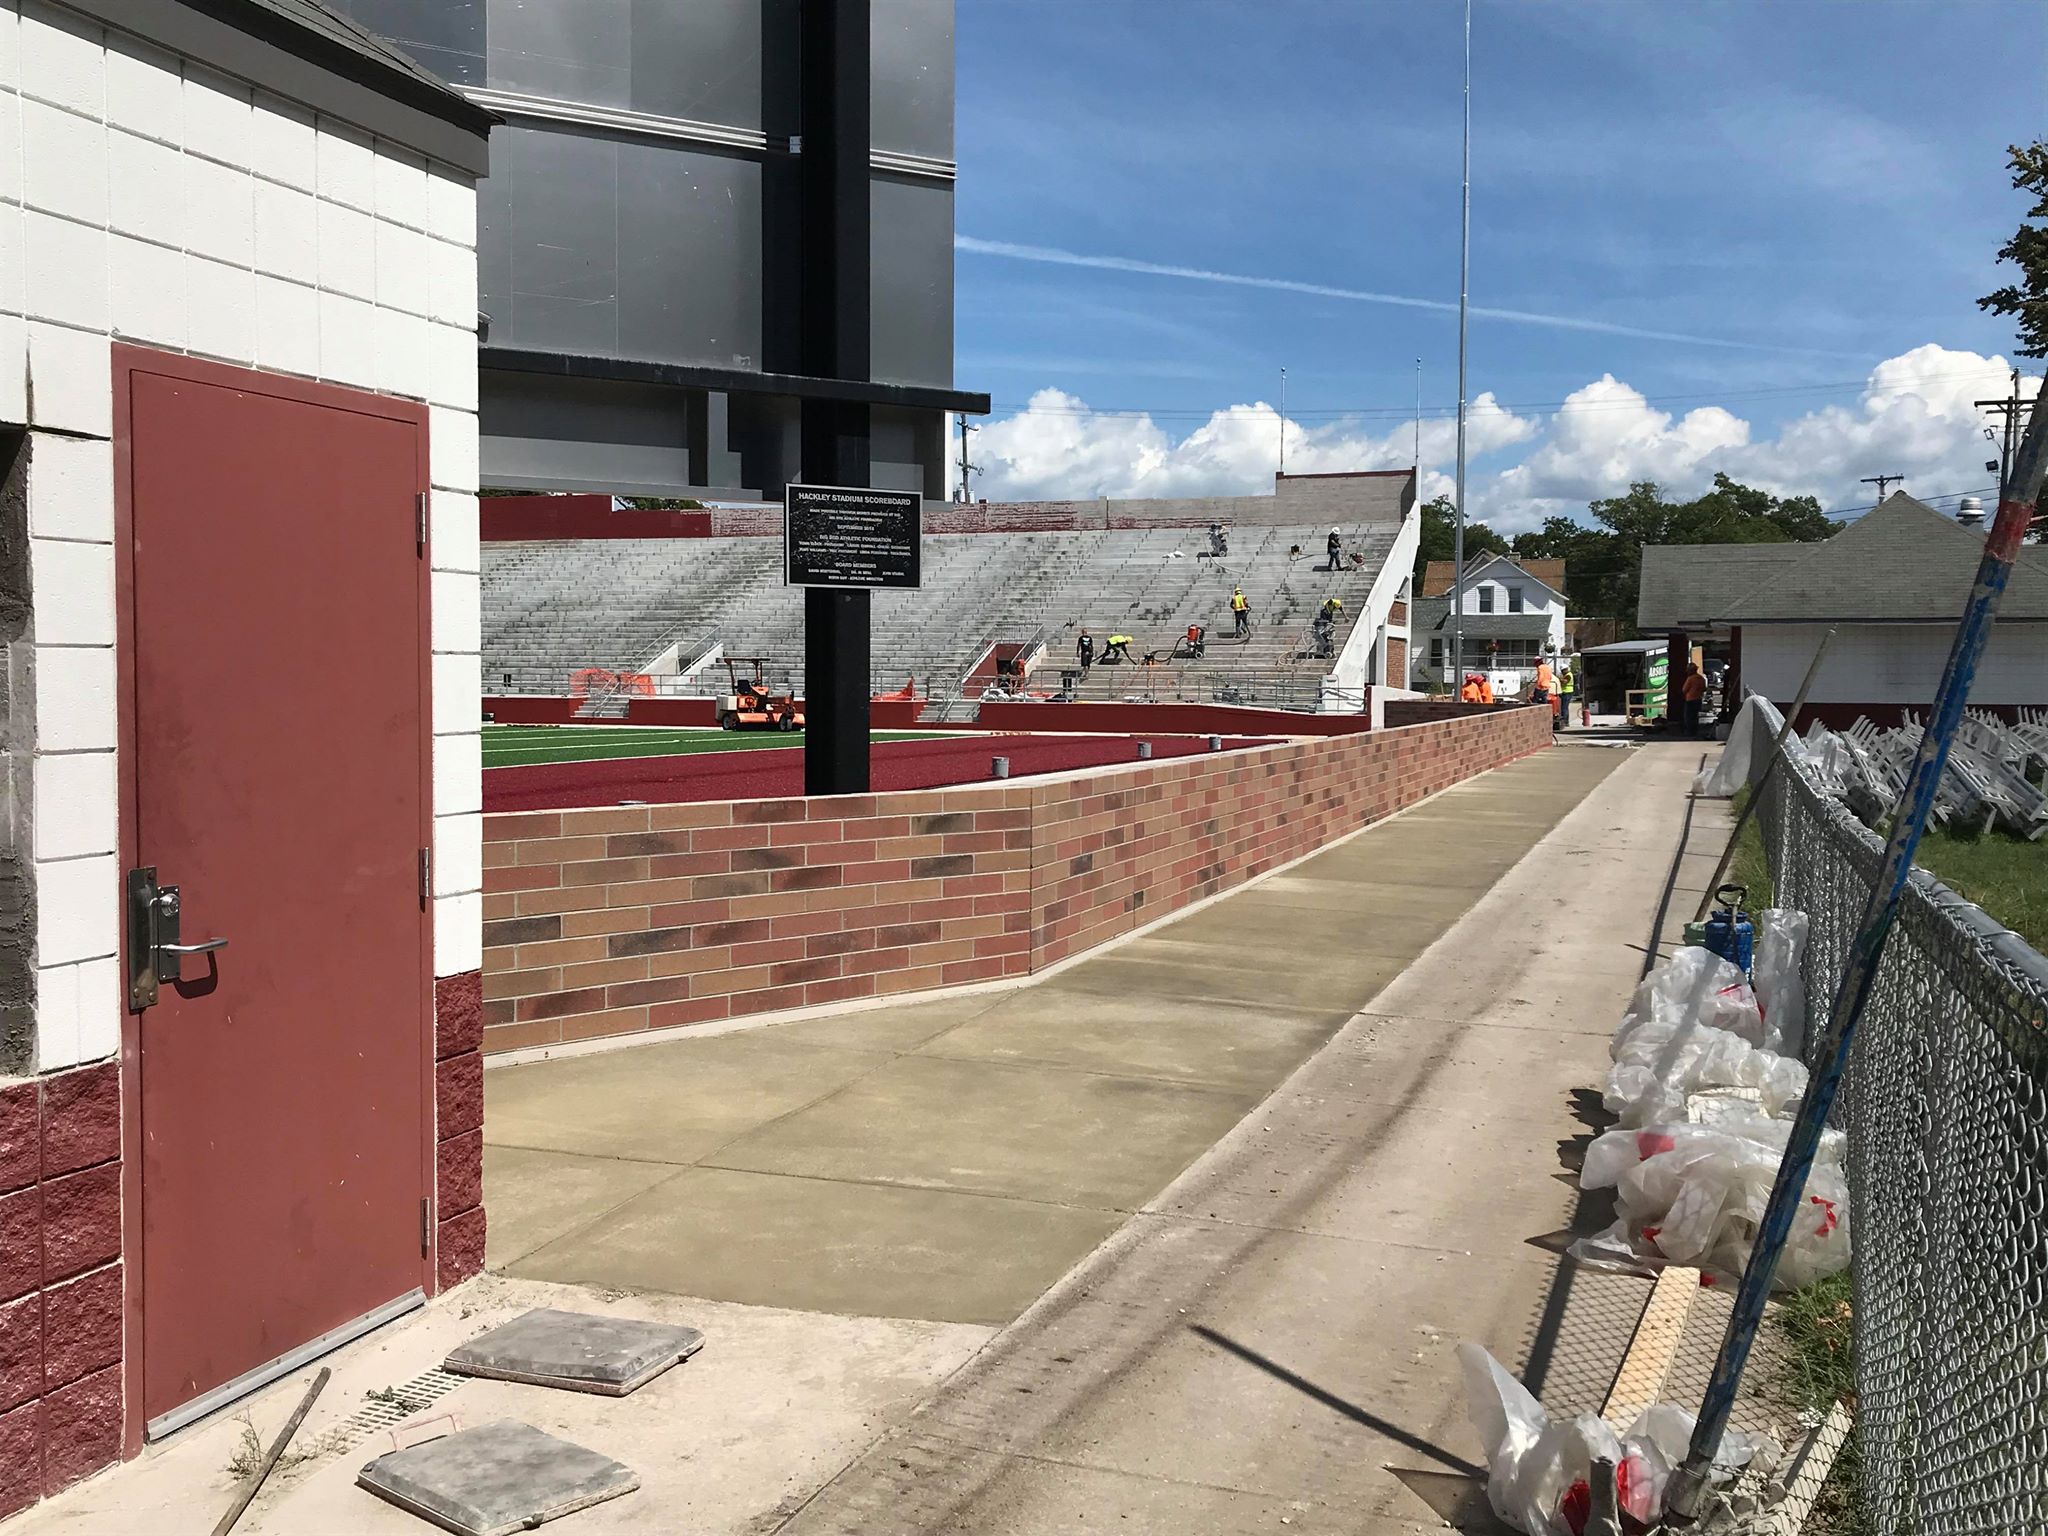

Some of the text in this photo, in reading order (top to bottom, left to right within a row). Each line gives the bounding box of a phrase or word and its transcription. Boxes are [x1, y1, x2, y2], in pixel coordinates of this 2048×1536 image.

[798, 492, 911, 505] HACKLEY STADIUM SCOREBOARD
